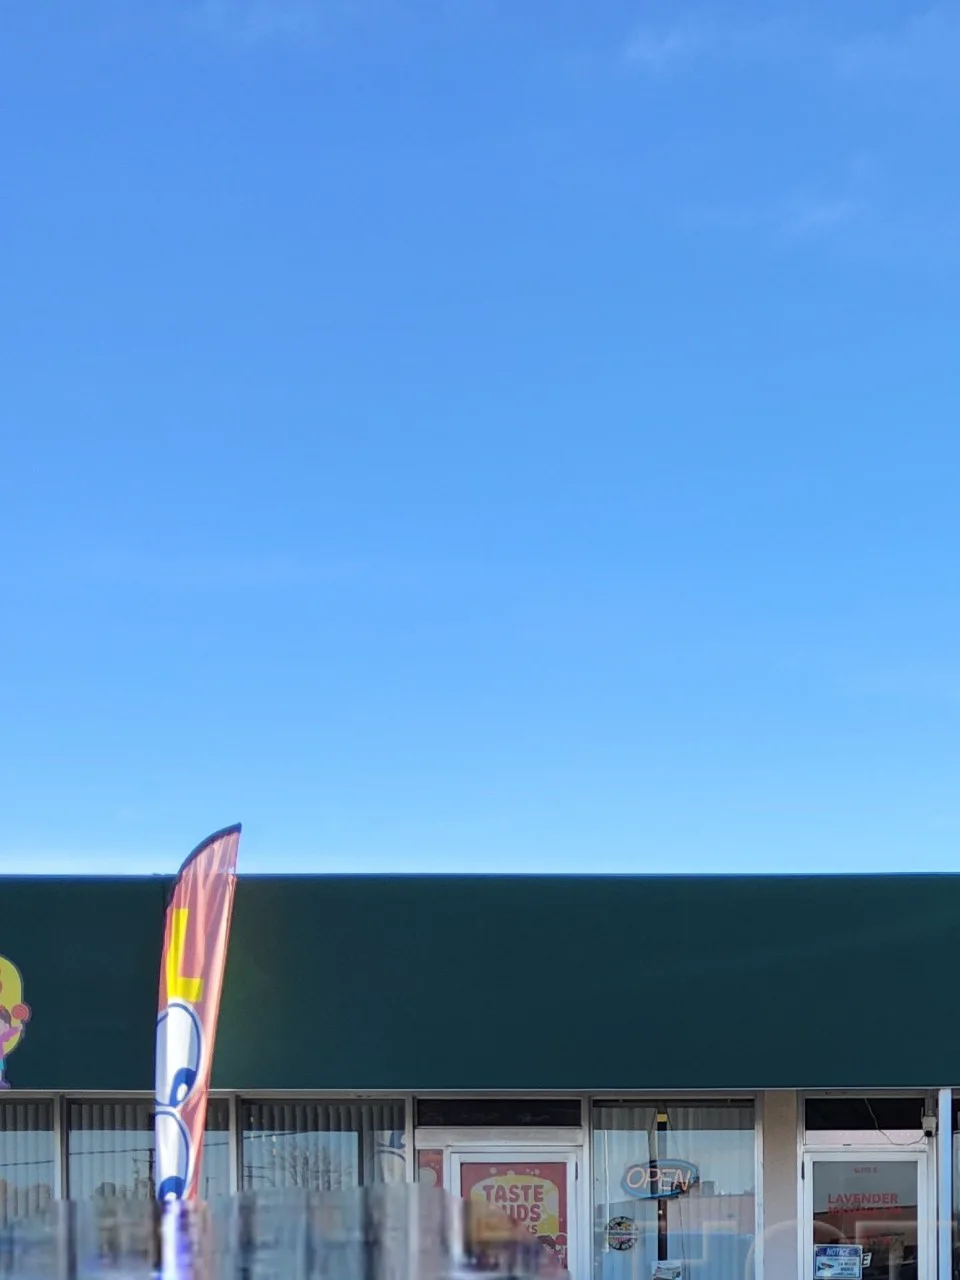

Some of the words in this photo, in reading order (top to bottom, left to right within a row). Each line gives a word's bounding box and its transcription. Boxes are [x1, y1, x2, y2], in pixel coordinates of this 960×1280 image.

[626, 1166, 692, 1191] OPEN
[482, 1184, 545, 1203] TASTE
[828, 1193, 899, 1204] LAVENDER
[826, 1247, 850, 1256] NOTICE
